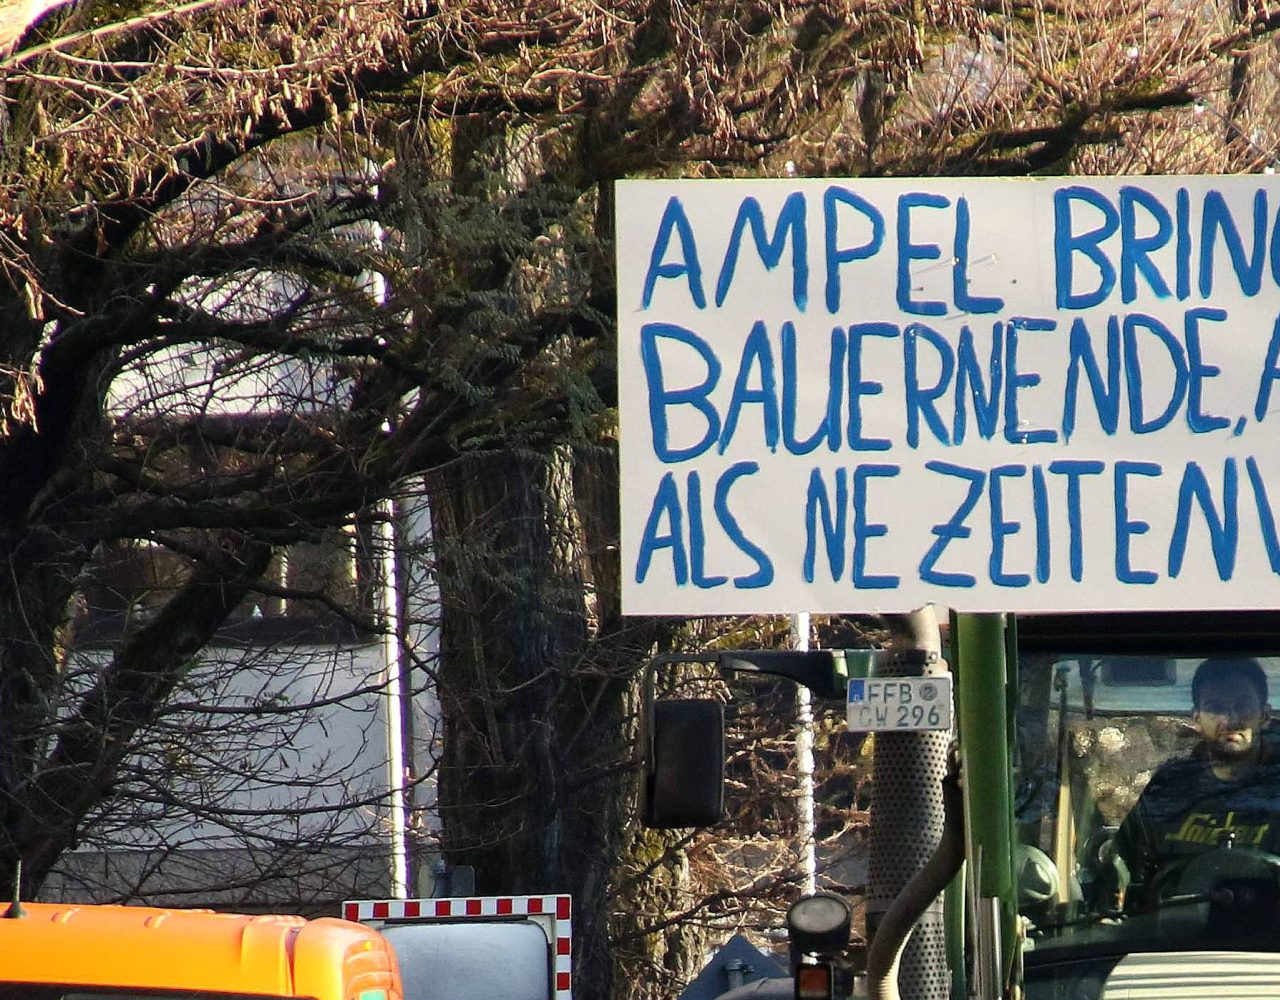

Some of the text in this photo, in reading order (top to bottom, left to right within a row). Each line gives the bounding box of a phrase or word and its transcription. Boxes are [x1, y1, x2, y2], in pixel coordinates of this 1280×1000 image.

[641, 184, 1005, 316] AMPEL
[640, 306, 1248, 464] BAUERNENDE,
[635, 460, 775, 590] ALS
[803, 464, 901, 590] NE
[868, 682, 912, 704] FFB
[896, 704, 940, 727] 296
